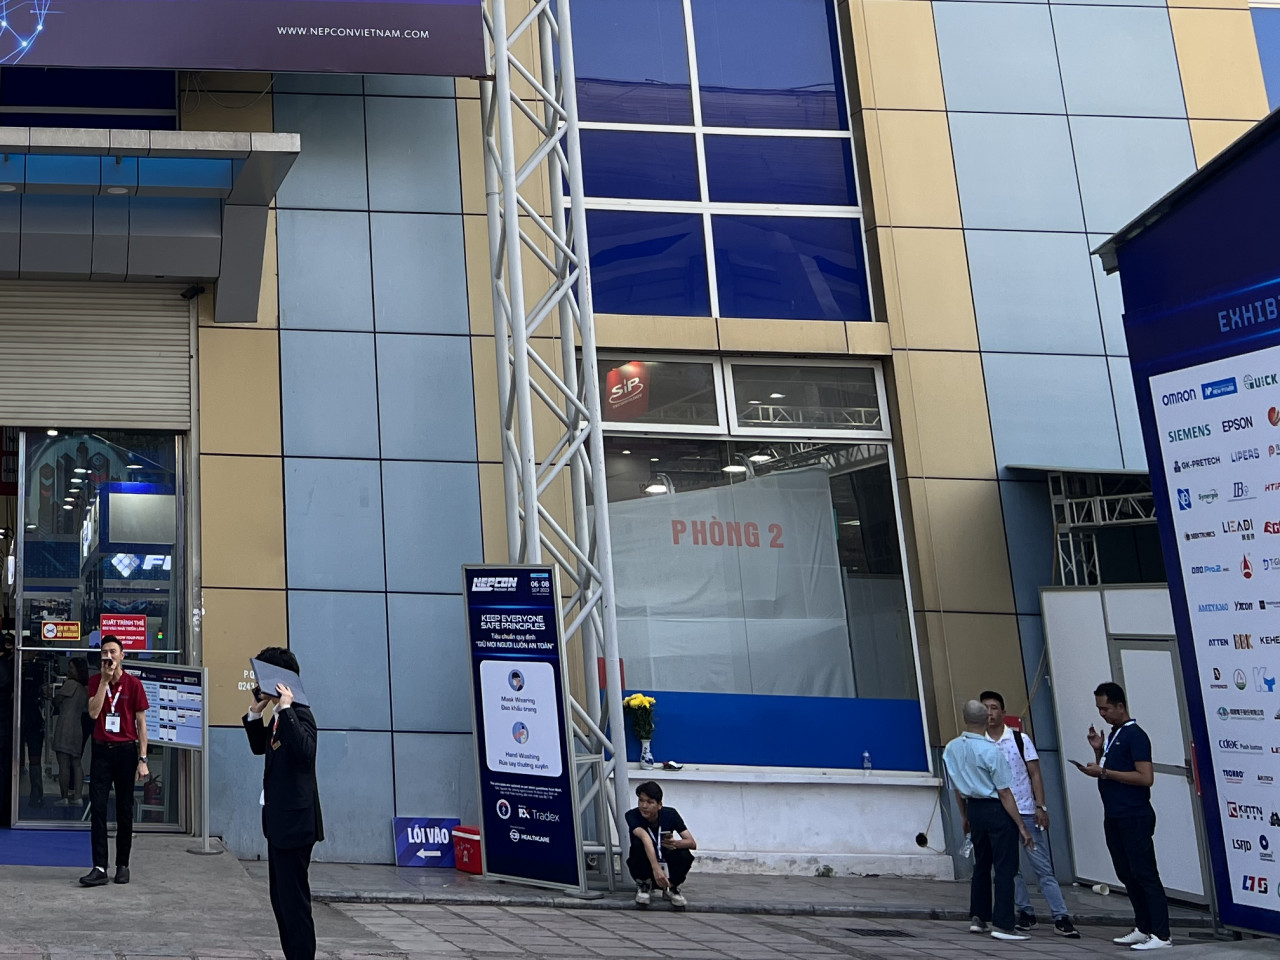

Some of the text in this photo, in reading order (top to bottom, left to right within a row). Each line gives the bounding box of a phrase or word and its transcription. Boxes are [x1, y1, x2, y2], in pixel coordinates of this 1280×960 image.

[277, 26, 430, 39] WWW.NEPCONVIETNAM.COM
[1218, 295, 1280, 333] EXHIB
[1222, 416, 1253, 433] EPSON
[1168, 424, 1211, 443] SIEMENS
[671, 515, 785, 548] PHÒNG 2
[481, 614, 500, 622] KEEP
[501, 622, 546, 630] PRINCIPLES
[531, 809, 560, 822] Tradex
[407, 823, 450, 844] LỐI VÀO
